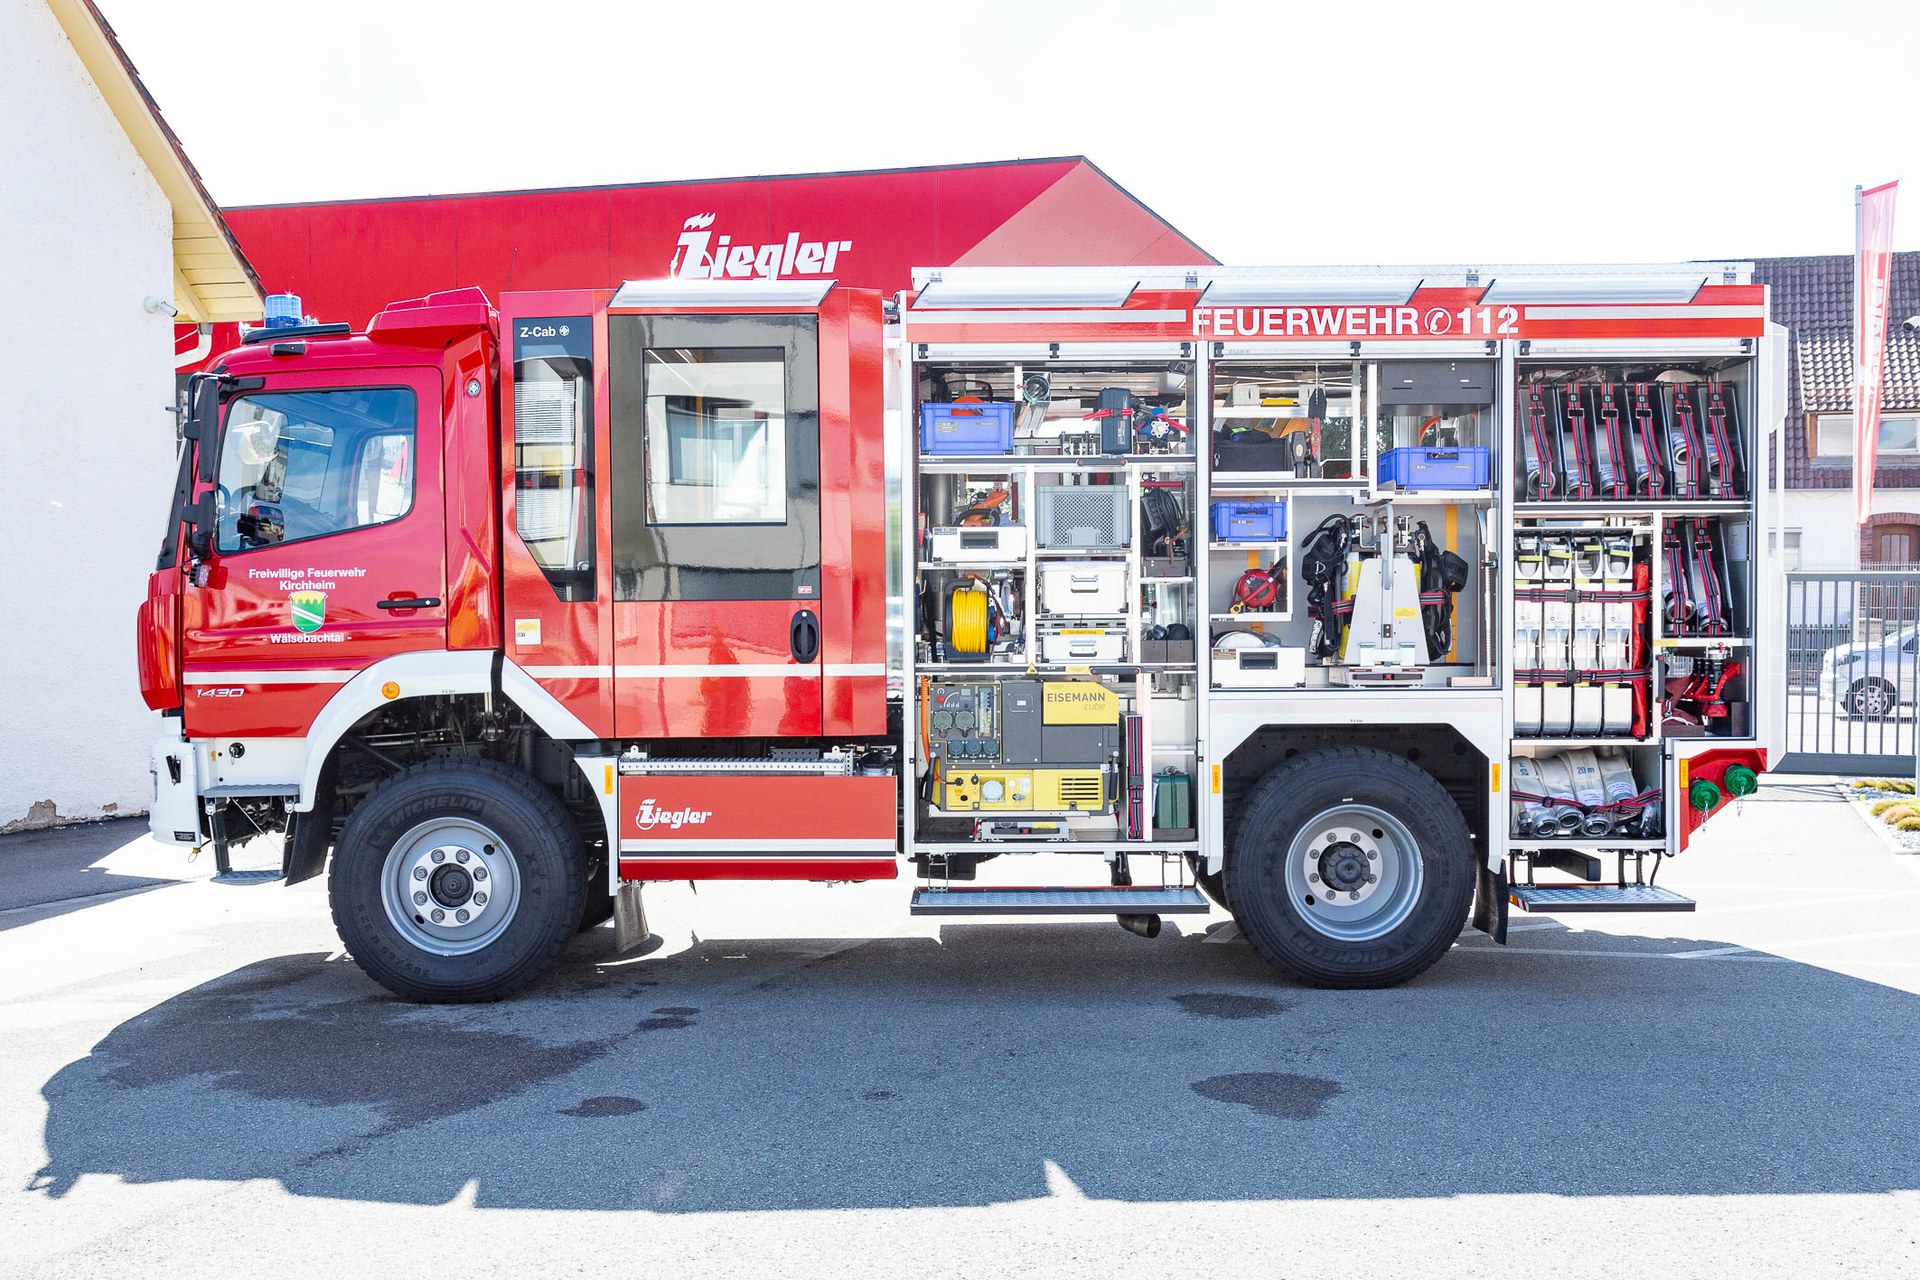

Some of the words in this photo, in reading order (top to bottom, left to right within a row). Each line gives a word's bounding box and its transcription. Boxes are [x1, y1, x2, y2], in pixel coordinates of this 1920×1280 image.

[672, 222, 852, 281] Ziegler
[1192, 307, 1419, 336] FEUERWEHR
[1456, 306, 1519, 334] 112
[520, 326, 556, 338] Z-Cab
[248, 568, 305, 580] Freiwillige
[307, 567, 367, 578] Feuerwehr
[279, 580, 336, 590] Kirchheim
[270, 632, 344, 643] Wälsebachtal
[196, 688, 245, 698] 1430
[1047, 692, 1106, 702] EISEMANN
[1083, 703, 1106, 711] cube
[1576, 766, 1586, 775] 20
[1587, 766, 1595, 774] m
[386, 793, 484, 830] MICHELIN
[637, 802, 713, 830] Ziegler
